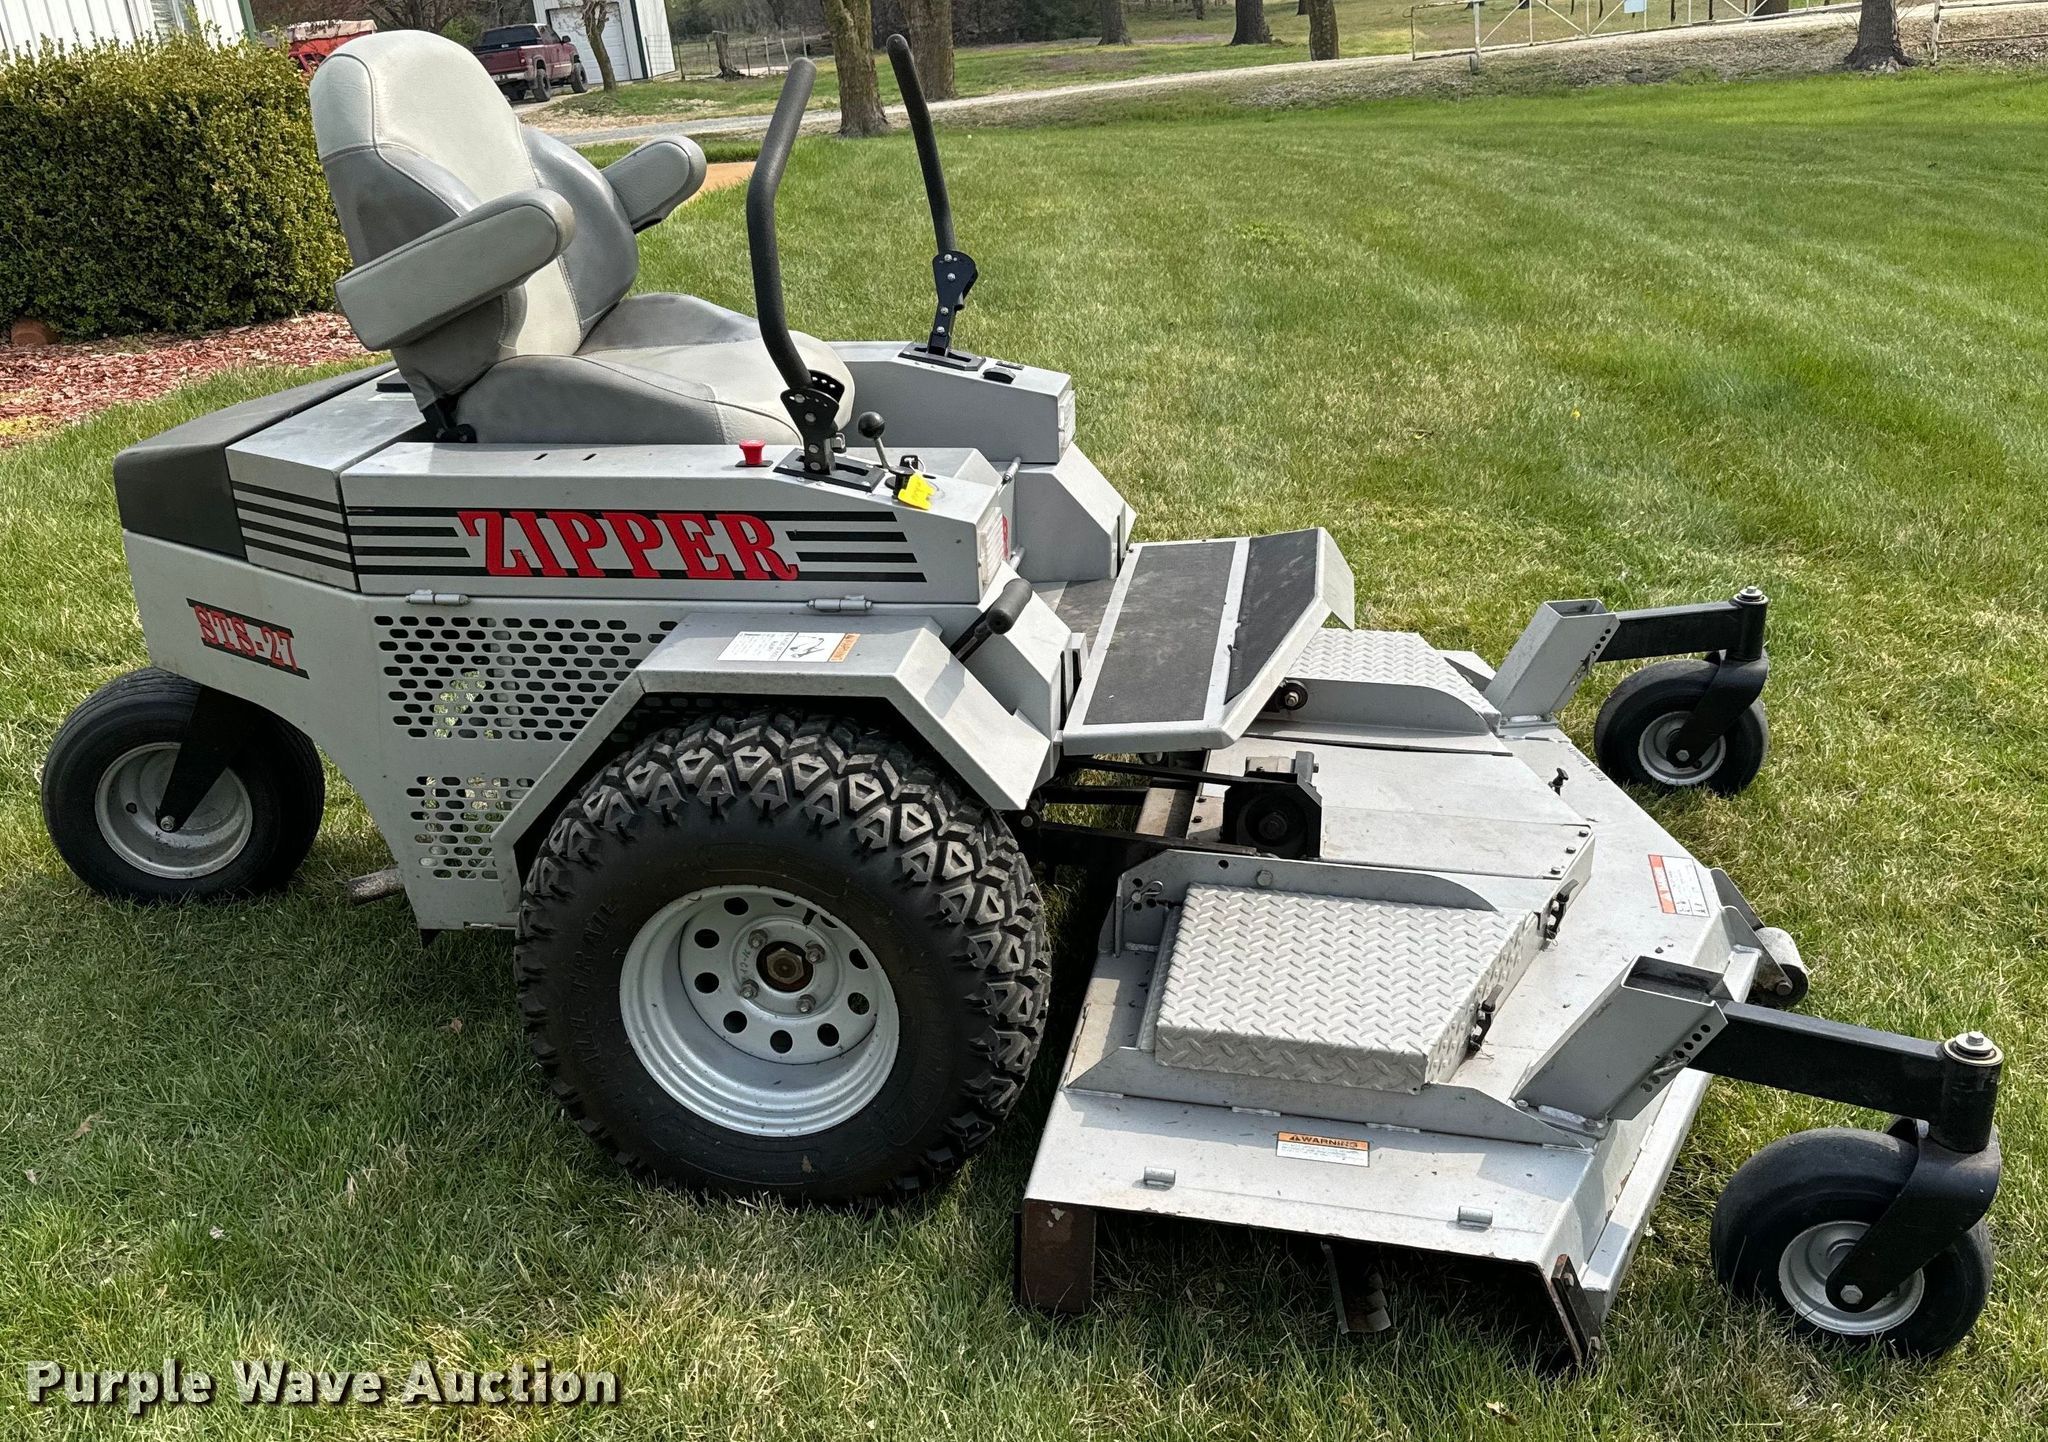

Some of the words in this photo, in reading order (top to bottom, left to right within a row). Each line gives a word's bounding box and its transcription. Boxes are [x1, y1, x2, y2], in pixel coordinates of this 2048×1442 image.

[457, 511, 799, 580] ZIPPER
[194, 605, 298, 671] STS-27
[1301, 1136, 1358, 1148] WARNING
